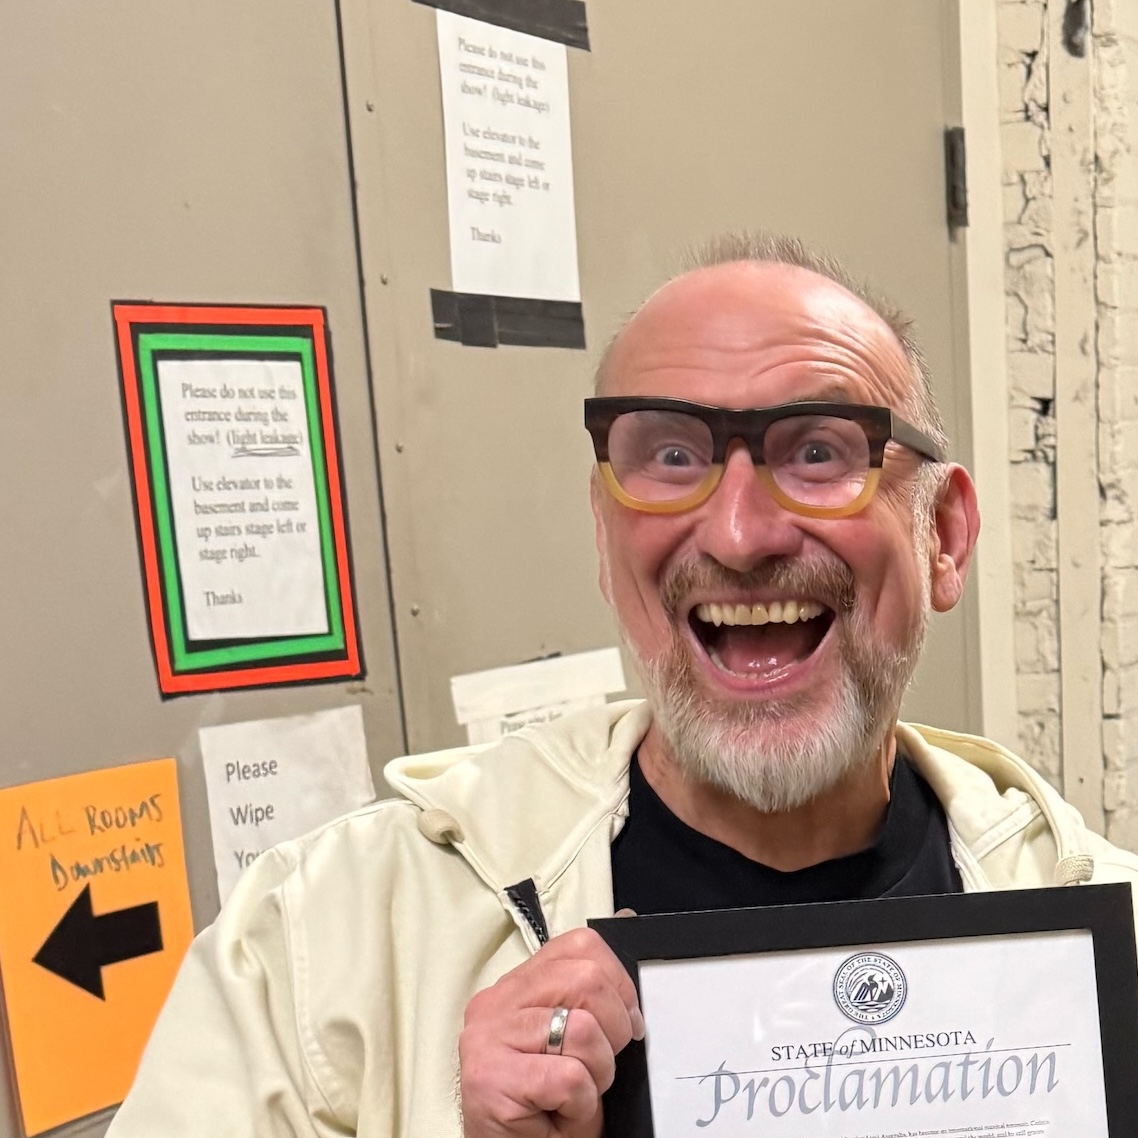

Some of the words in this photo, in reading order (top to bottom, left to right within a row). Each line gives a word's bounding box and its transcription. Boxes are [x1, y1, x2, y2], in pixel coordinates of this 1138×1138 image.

[225, 759, 278, 783] Please
[84, 793, 164, 836] ROOMS
[229, 803, 275, 828] Wipe
[769, 1041, 834, 1061] STATE
[837, 1039, 859, 1059] of
[858, 1029, 977, 1054] MINNESOTA
[695, 1024, 1060, 1128] Proclamation
